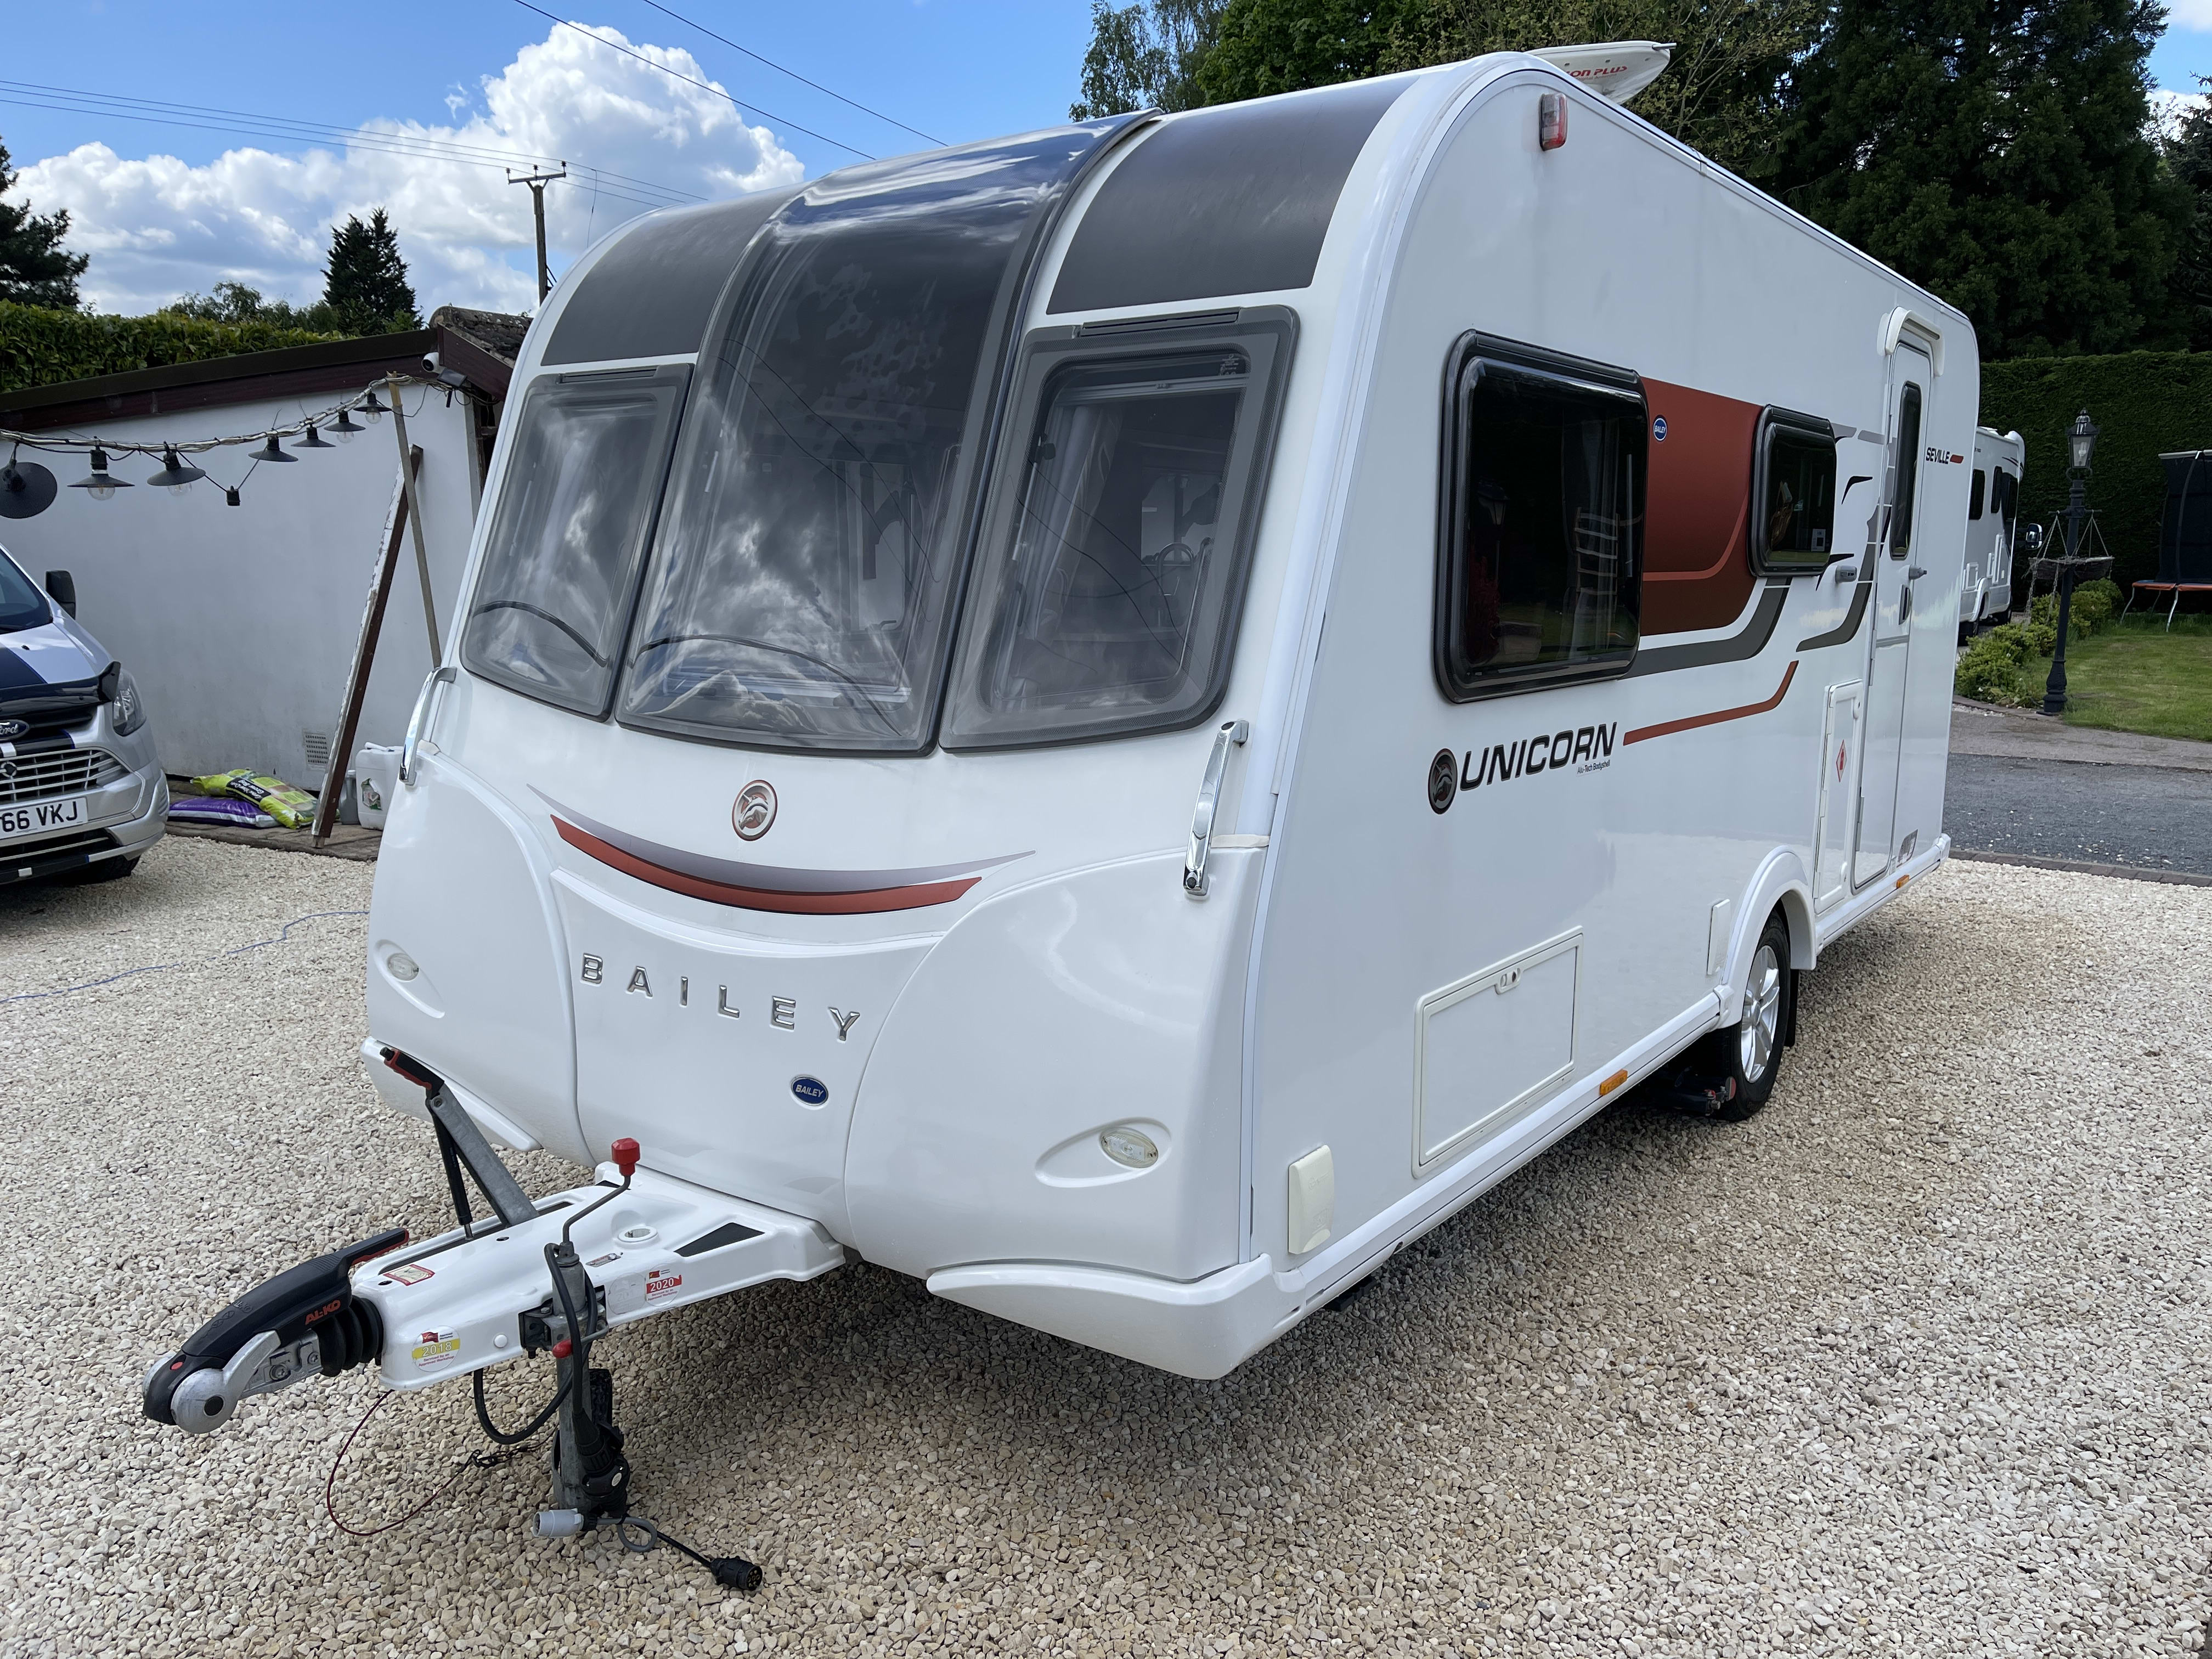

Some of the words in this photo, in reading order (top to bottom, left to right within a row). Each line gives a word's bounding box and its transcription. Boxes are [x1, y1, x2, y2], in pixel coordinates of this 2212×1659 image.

[1594, 66, 1628, 76] PLUS
[1654, 425, 1666, 433] BAILEY
[1926, 447, 1950, 465] SEVILLE
[1459, 721, 1617, 791] UNICORN
[1577, 764, 1593, 774] Alu-Tech
[1593, 759, 1611, 771] Bodyshell
[0, 810, 30, 832] 66
[36, 801, 78, 826] VKJ
[580, 952, 861, 1042] BAILEY
[795, 1084, 824, 1098] BAILEY
[650, 1278, 674, 1292] 2020
[305, 1300, 341, 1325] AL-KO
[422, 1341, 452, 1357] 2018
